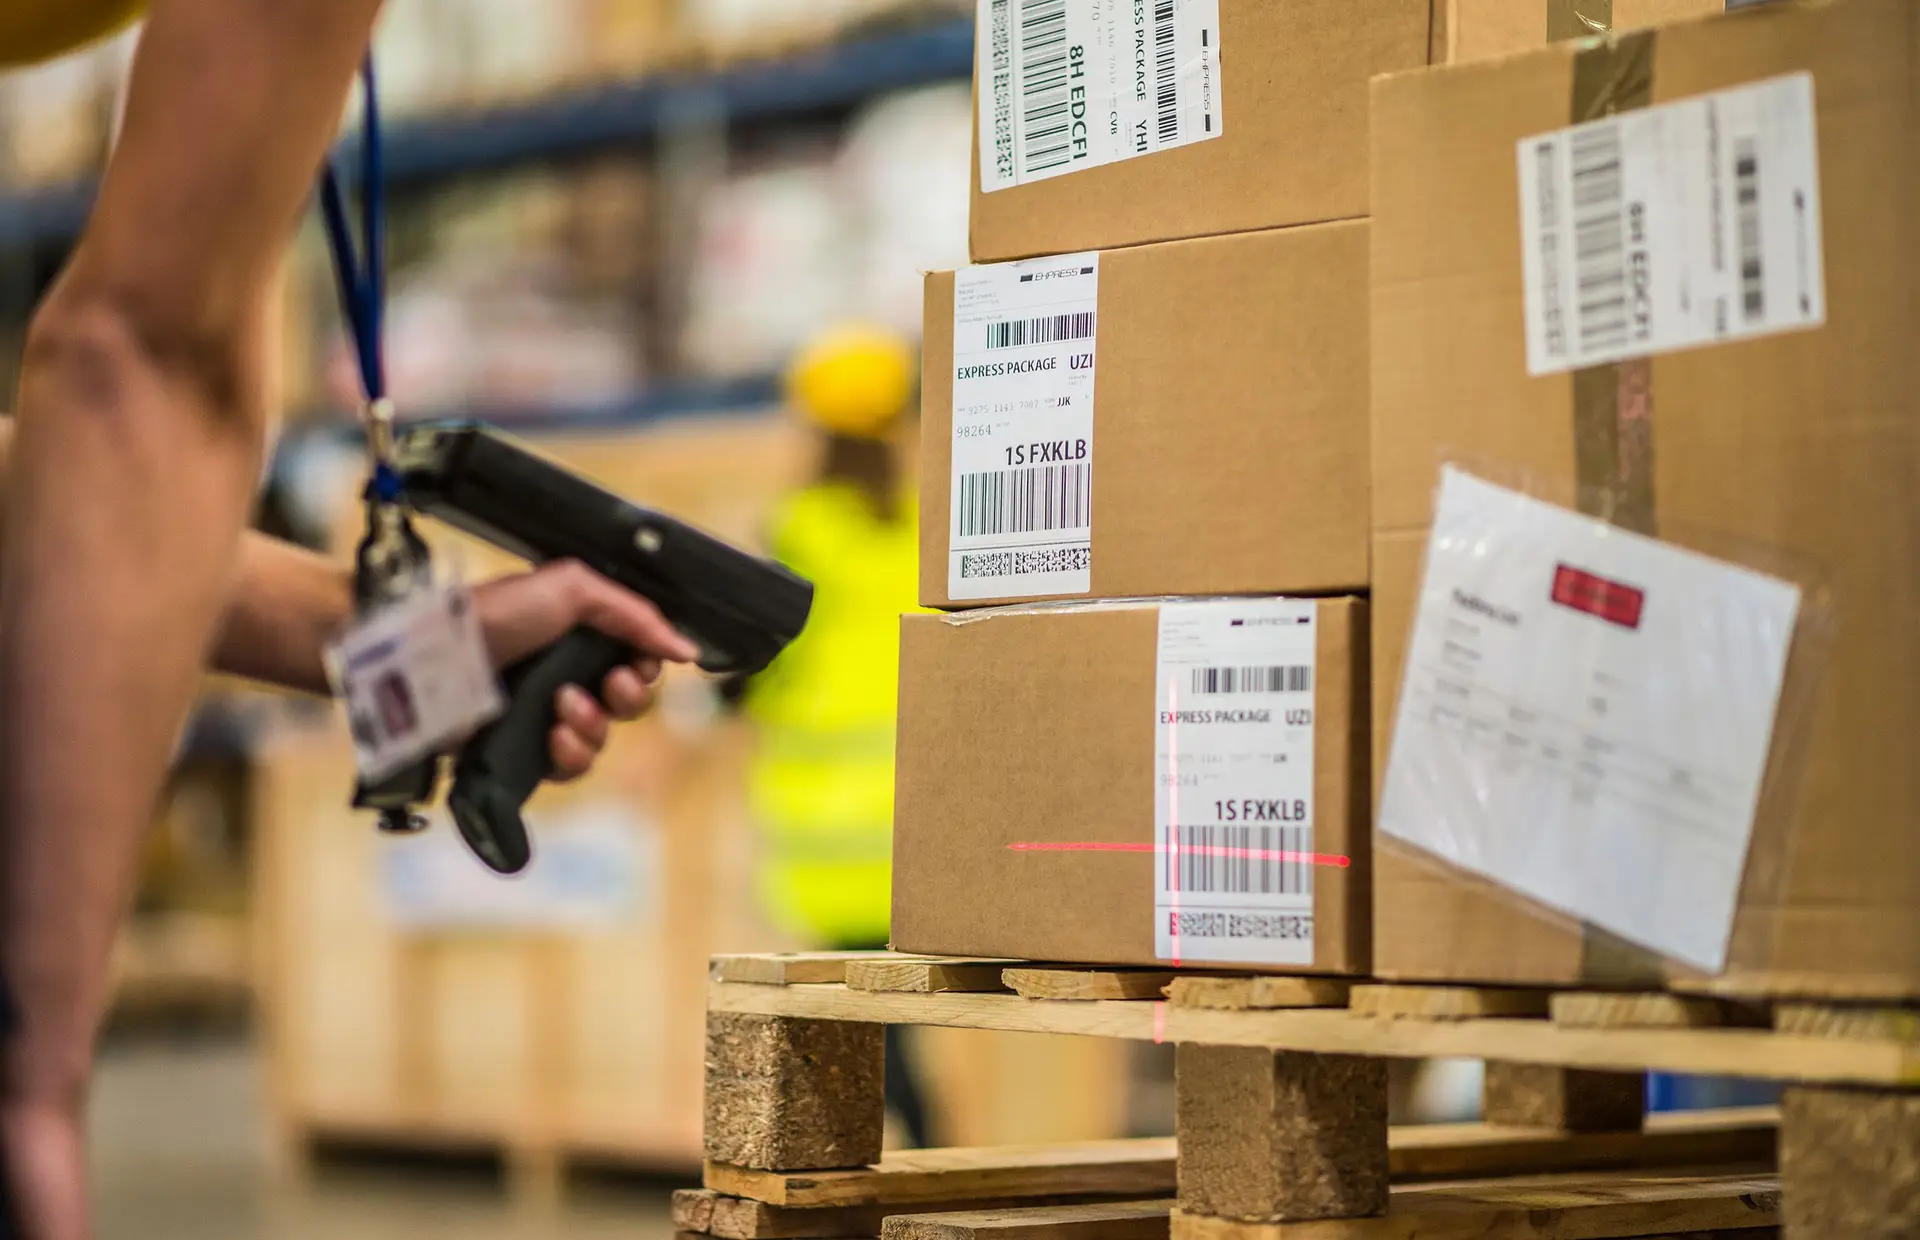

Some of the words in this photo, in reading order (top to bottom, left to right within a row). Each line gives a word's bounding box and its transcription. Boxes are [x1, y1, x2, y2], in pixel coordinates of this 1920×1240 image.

[1069, 45, 1085, 79] 8H
[1135, 29, 1147, 102] PACKAGE
[1070, 85, 1087, 160] EDCFI
[1110, 111, 1118, 135] CVB
[1136, 120, 1148, 152] YHI
[957, 363, 1004, 380] EXPRESS
[1007, 357, 1057, 374] PACKAGE
[1070, 353, 1093, 370] UZI
[1056, 397, 1071, 407] JJK
[957, 424, 992, 438] 98264
[1005, 445, 1025, 465] 1S
[1029, 439, 1087, 464] FXKLB
[1160, 711, 1212, 724] EXPRESS
[1214, 709, 1271, 723] PACKAGE
[1215, 800, 1237, 820] 1S
[1243, 799, 1306, 821] FXKLB
